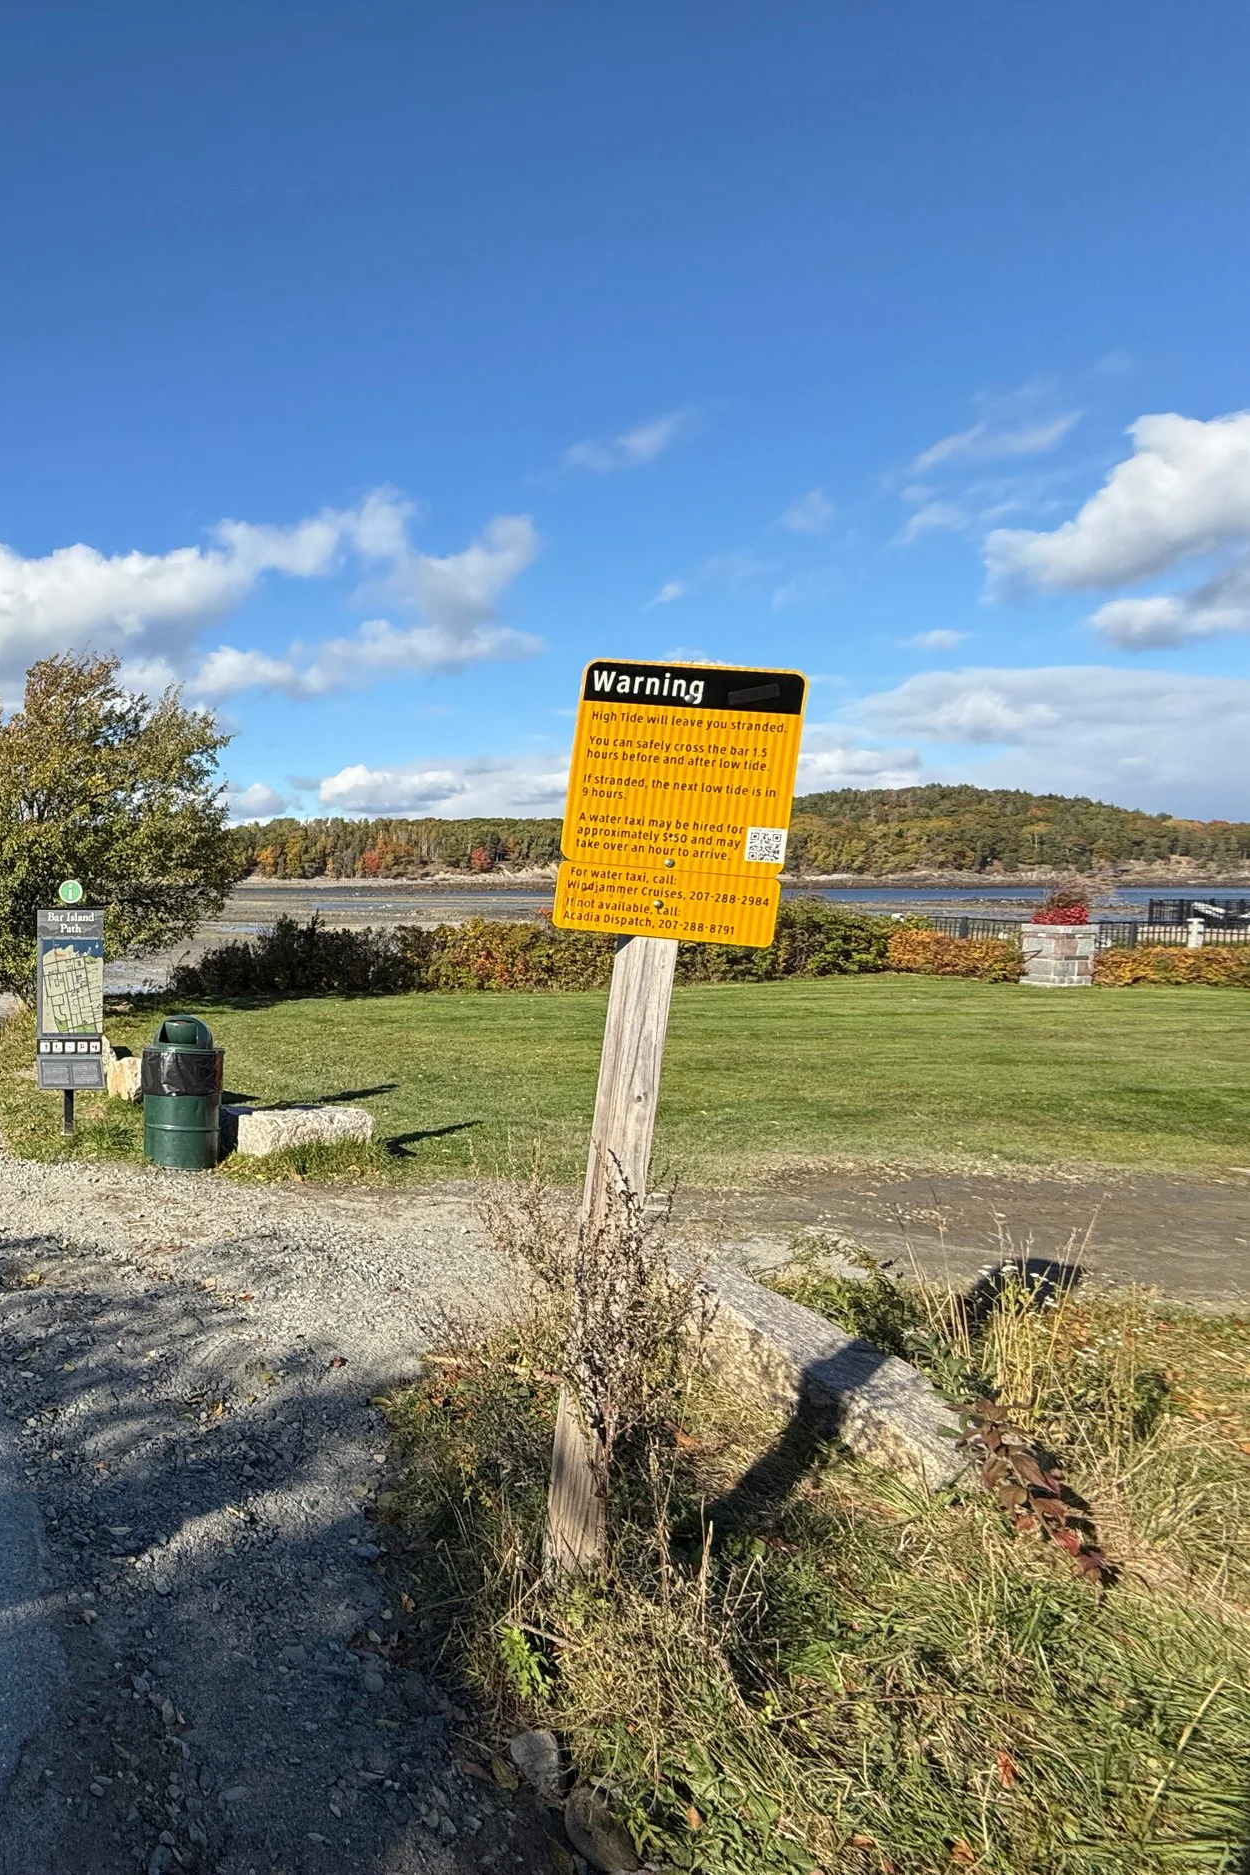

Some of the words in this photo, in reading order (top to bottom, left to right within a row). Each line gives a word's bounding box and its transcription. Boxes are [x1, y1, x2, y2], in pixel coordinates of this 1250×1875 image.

[593, 670, 704, 704] Warning
[592, 711, 617, 723] High
[621, 712, 643, 723] Tide
[647, 715, 668, 725] will
[671, 716, 703, 727] leave
[706, 720, 727, 730] you
[731, 721, 787, 733] stranded.
[590, 735, 609, 746] You
[613, 738, 632, 748] can
[636, 739, 671, 753] safely
[674, 743, 704, 753] cross
[708, 744, 727, 755] the
[730, 745, 749, 756] bar
[753, 747, 767, 757] 1.5
[587, 748, 619, 760] hours
[622, 751, 659, 763] before
[663, 756, 684, 765] and
[688, 756, 716, 767] after
[719, 758, 741, 769] low
[744, 760, 770, 771] tide.
[582, 787, 588, 796] 9
[592, 787, 626, 800] hours.
[583, 773, 592, 783] If
[594, 775, 648, 789] stranded,
[652, 779, 669, 789] the
[673, 781, 698, 791] next
[701, 782, 722, 793] low
[726, 784, 748, 795] tide
[752, 786, 761, 797] is
[765, 786, 776, 798] in
[579, 812, 585, 821] A
[590, 814, 622, 824] water
[624, 816, 645, 826] taxi
[648, 819, 672, 830] may
[675, 819, 689, 830] be
[693, 821, 723, 833] hired
[727, 824, 745, 834] for
[577, 826, 659, 843] approximately
[663, 832, 687, 843] $50
[691, 836, 713, 846] and
[716, 839, 740, 850] may
[576, 838, 600, 849] take
[603, 841, 628, 852] over
[631, 844, 644, 853] an
[648, 845, 675, 855] hour
[678, 847, 689, 857] to
[693, 849, 731, 861] arrive.
[571, 867, 587, 877] For
[591, 869, 622, 880] water
[626, 872, 649, 883] taxi,
[653, 875, 677, 885] call:
[567, 880, 638, 895] Windjammer
[641, 887, 686, 900] Cruises,
[690, 891, 769, 906] 207-288-2984
[47, 912, 64, 922] Bar
[66, 912, 95, 922] Island
[566, 897, 574, 906] If
[577, 899, 595, 908] not
[598, 901, 653, 915] available,
[657, 907, 681, 916] call:
[60, 923, 82, 933] Path
[563, 911, 600, 922] Acadia
[604, 914, 655, 928] Dispatch,
[658, 919, 734, 935] 207-288-8791
